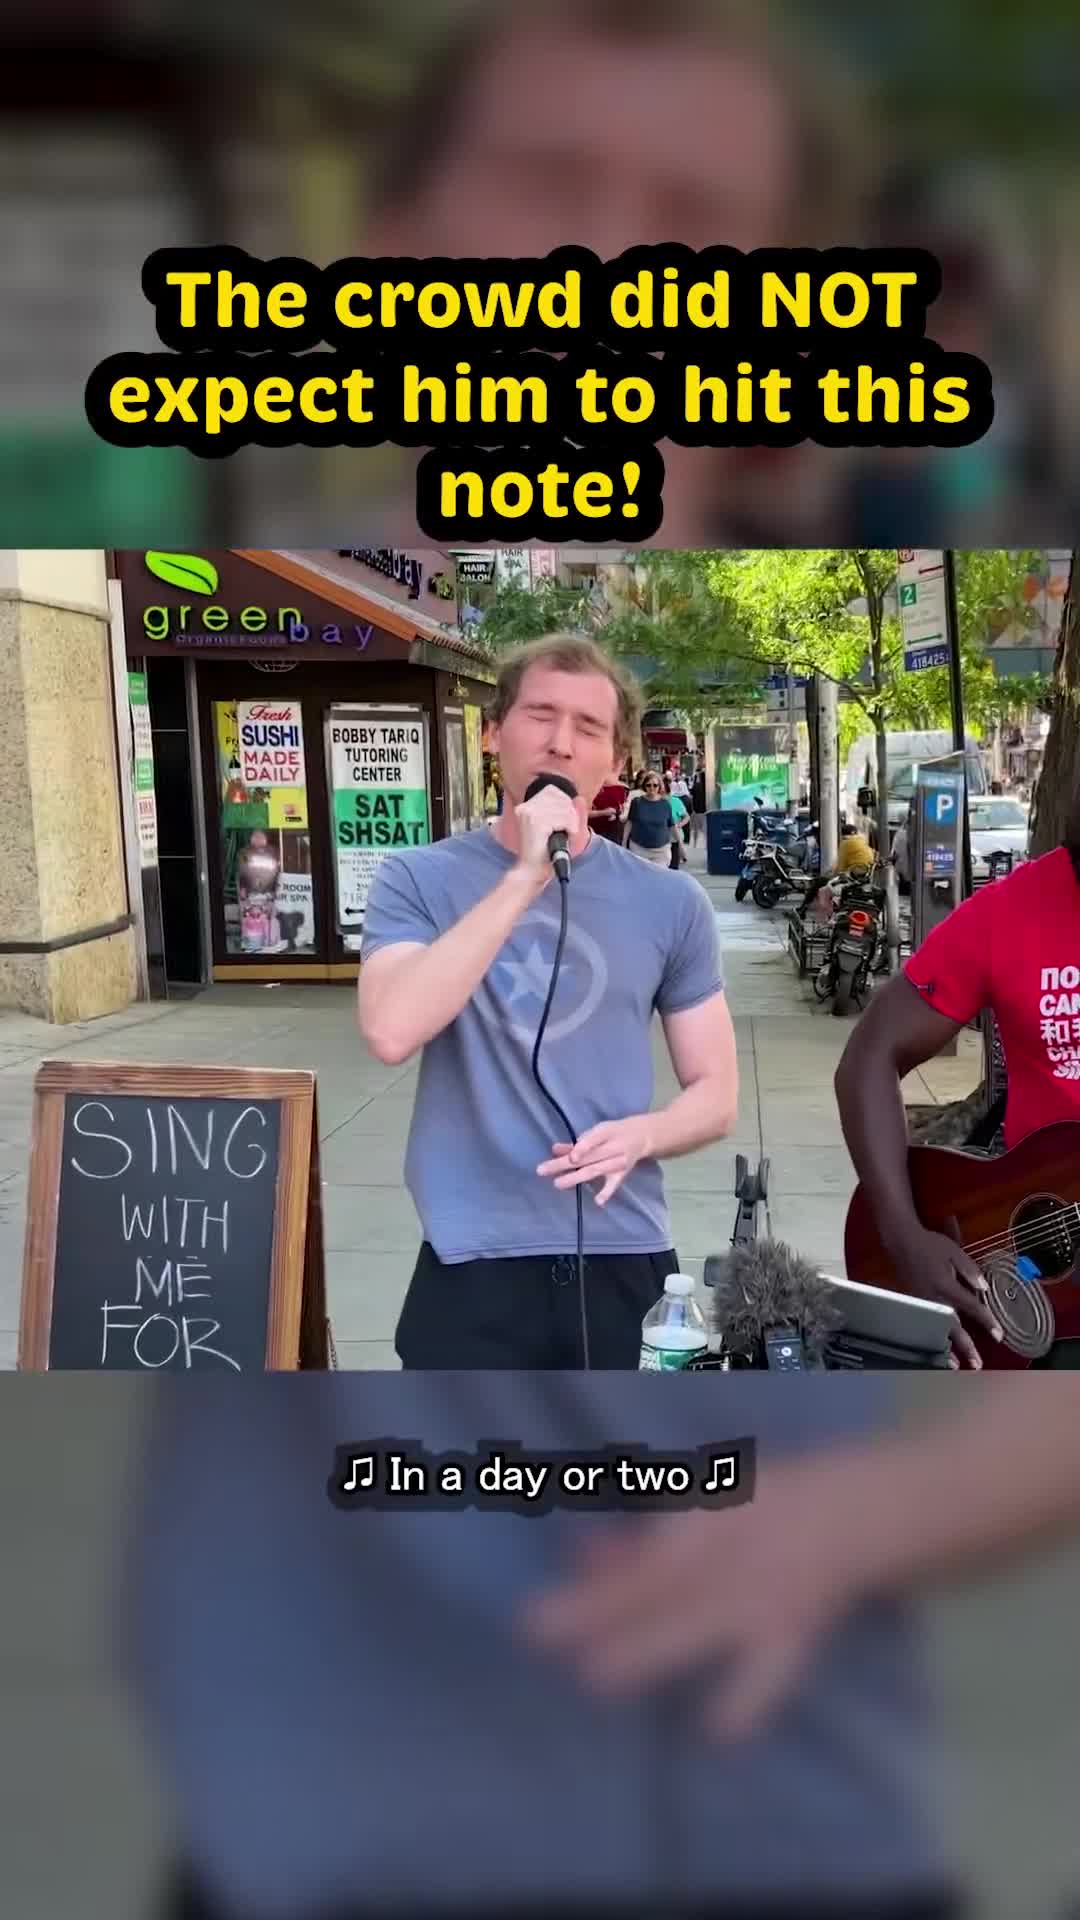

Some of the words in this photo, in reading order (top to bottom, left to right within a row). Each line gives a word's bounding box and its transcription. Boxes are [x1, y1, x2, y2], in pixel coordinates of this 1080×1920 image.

[463, 563, 487, 573] HAIR
[904, 586, 914, 605] 2
[143, 605, 302, 640] green
[290, 617, 374, 650] bay
[246, 705, 293, 721] Fresh
[242, 725, 300, 747] SUSHI
[332, 728, 376, 744] BOBBY
[380, 728, 420, 744] TARIQ
[243, 751, 300, 765] MADE
[345, 748, 409, 762] TUTORING
[245, 767, 300, 781] DAILY
[353, 767, 402, 781] CENTER
[355, 794, 404, 818] SAT
[936, 794, 954, 821] P
[338, 821, 424, 845] SHSAT
[1040, 965, 1080, 990] ПО
[71, 1101, 267, 1178] SING
[121, 1193, 228, 1253] WITH
[135, 1256, 212, 1307] ME
[101, 1299, 241, 1371] FOR
